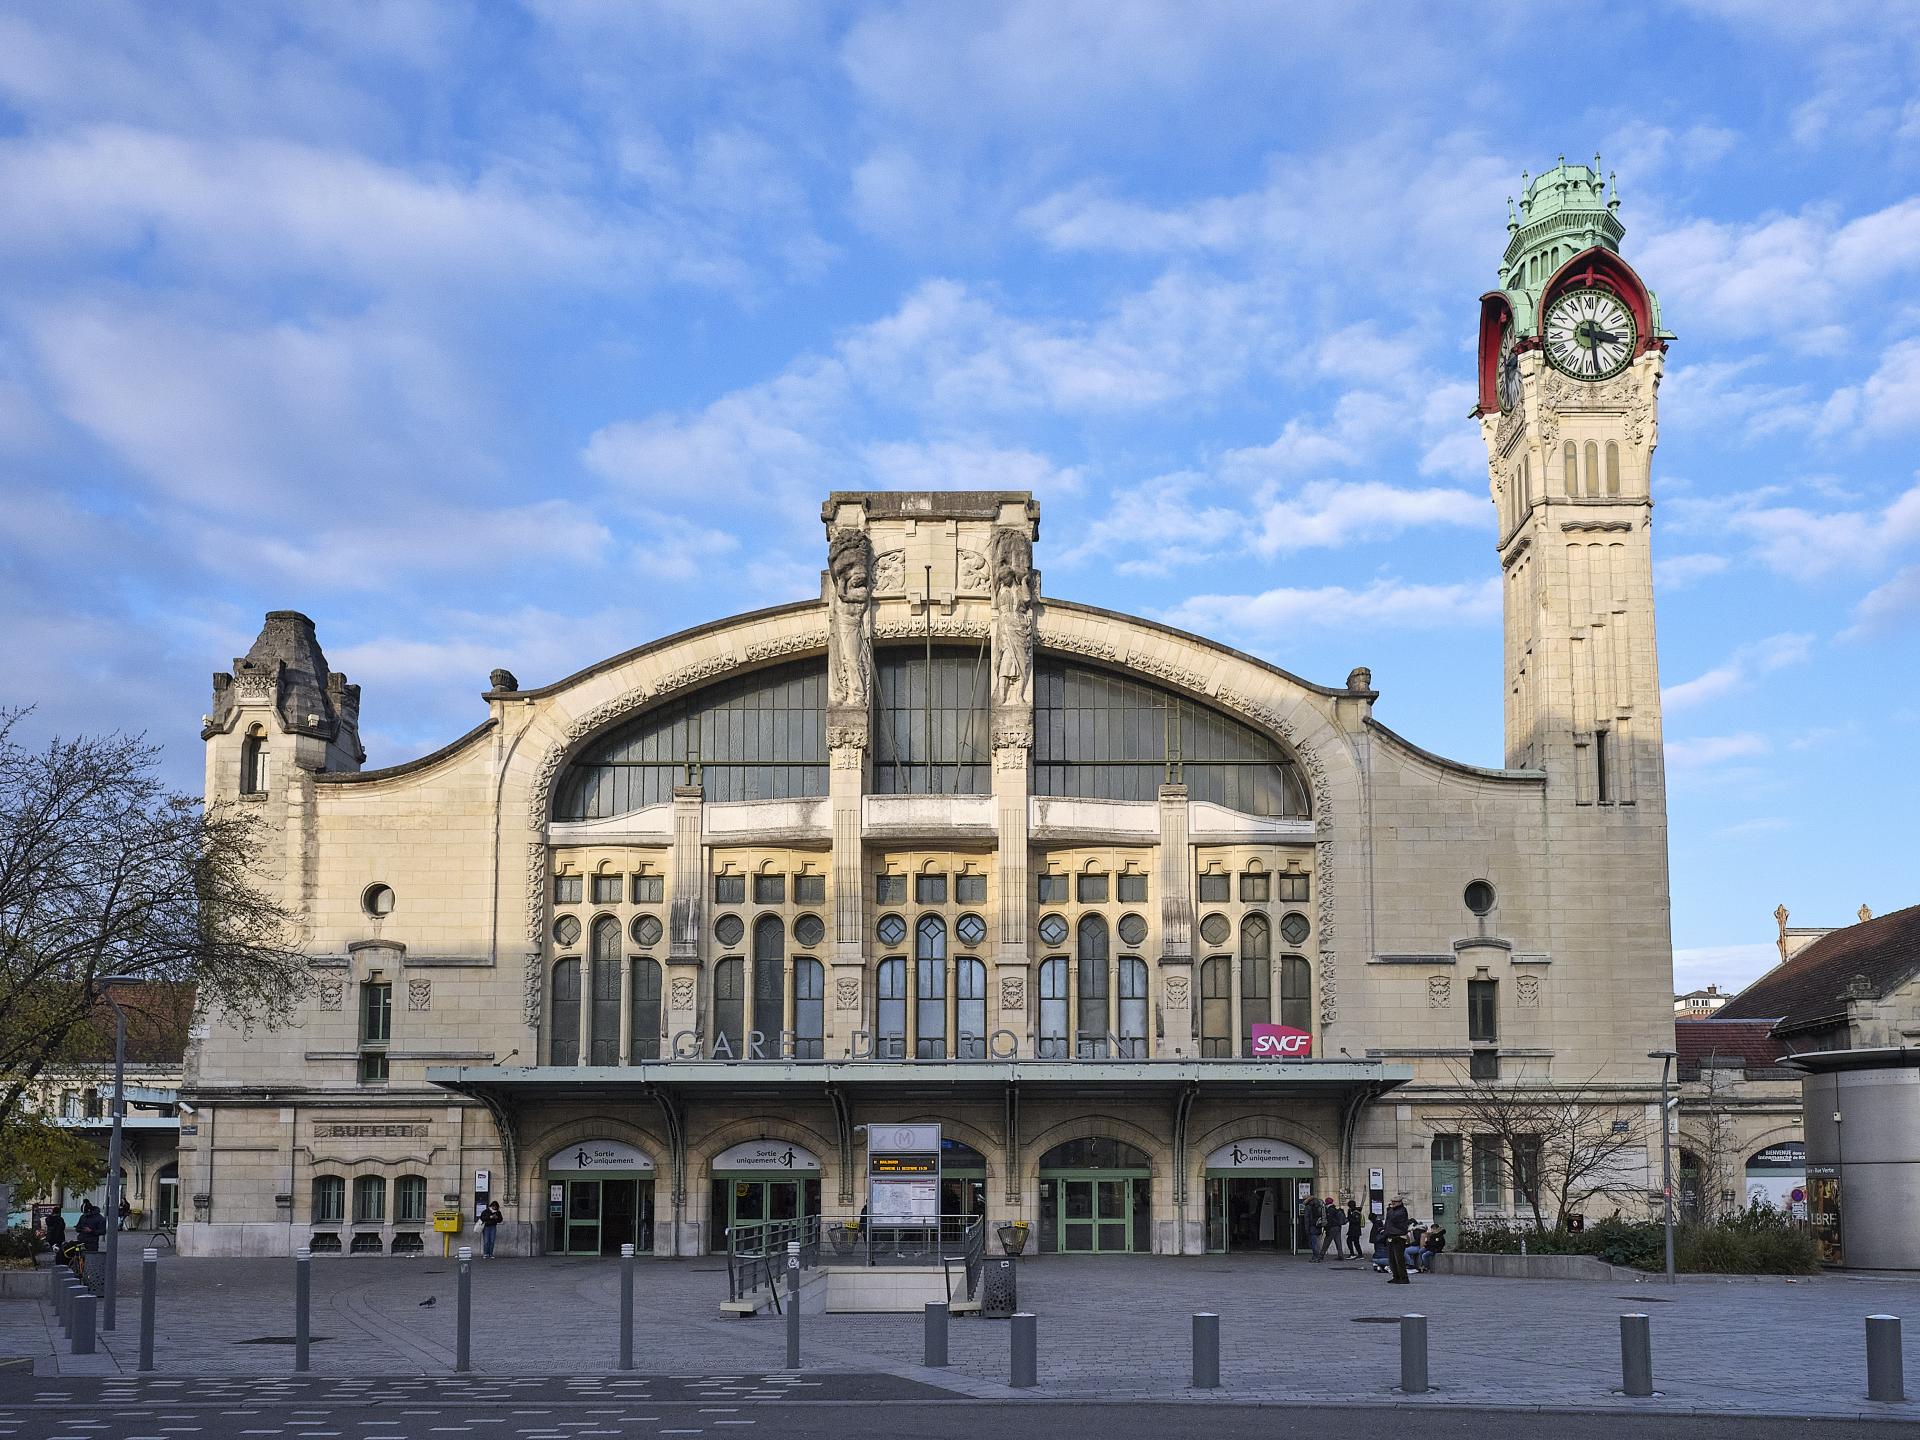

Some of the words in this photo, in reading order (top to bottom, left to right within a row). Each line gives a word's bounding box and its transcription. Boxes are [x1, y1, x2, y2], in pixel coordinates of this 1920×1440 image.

[672, 1030, 796, 1059] GARE
[851, 1030, 904, 1059] DE
[957, 1029, 1131, 1059] ROUEN
[1255, 1035, 1310, 1052] SNCF
[332, 1125, 412, 1137] BUFFET
[1249, 1147, 1271, 1155] Entrée
[593, 1157, 635, 1165] uniquement
[736, 1157, 777, 1165] uniquement
